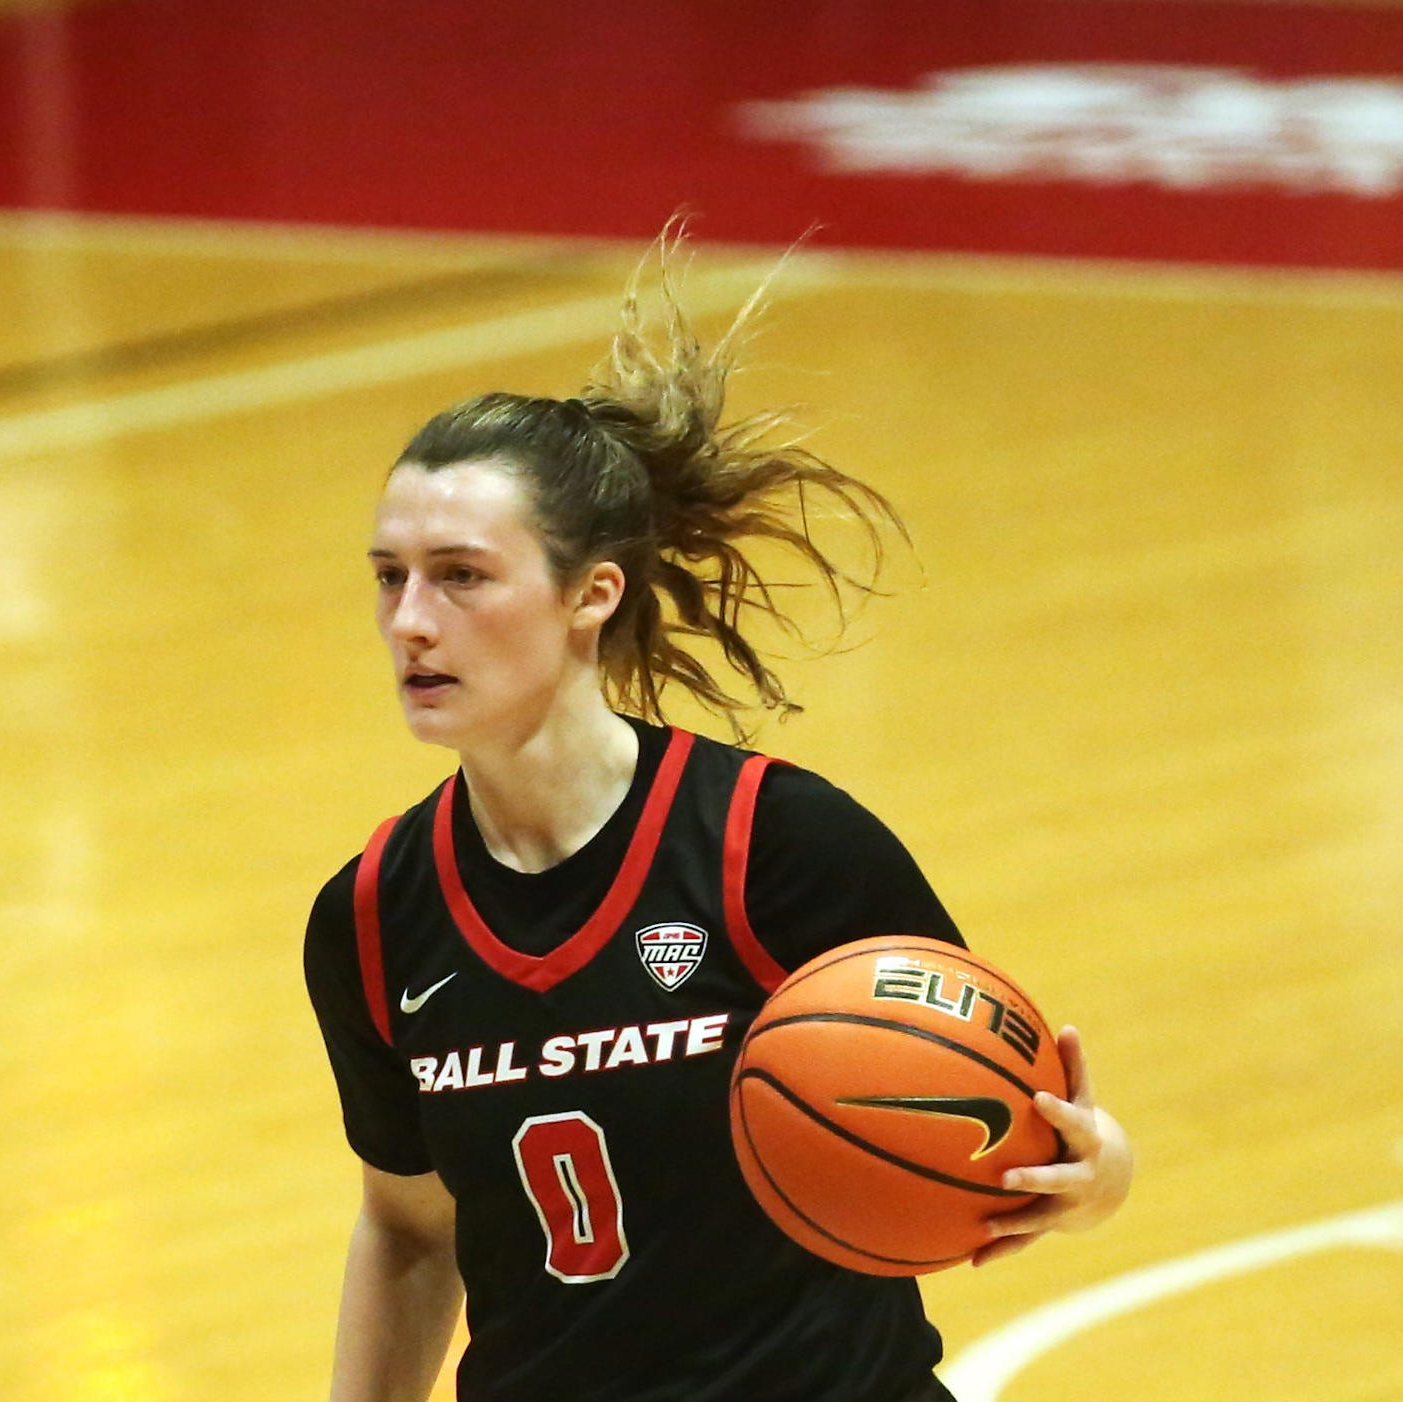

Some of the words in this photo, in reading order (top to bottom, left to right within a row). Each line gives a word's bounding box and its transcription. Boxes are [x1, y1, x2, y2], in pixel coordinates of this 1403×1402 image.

[643, 944, 702, 961] MAC
[410, 1041, 528, 1092] BALL
[538, 1013, 730, 1077] STATE
[873, 966, 1040, 1066] ELITE
[511, 1110, 630, 1284] 0
